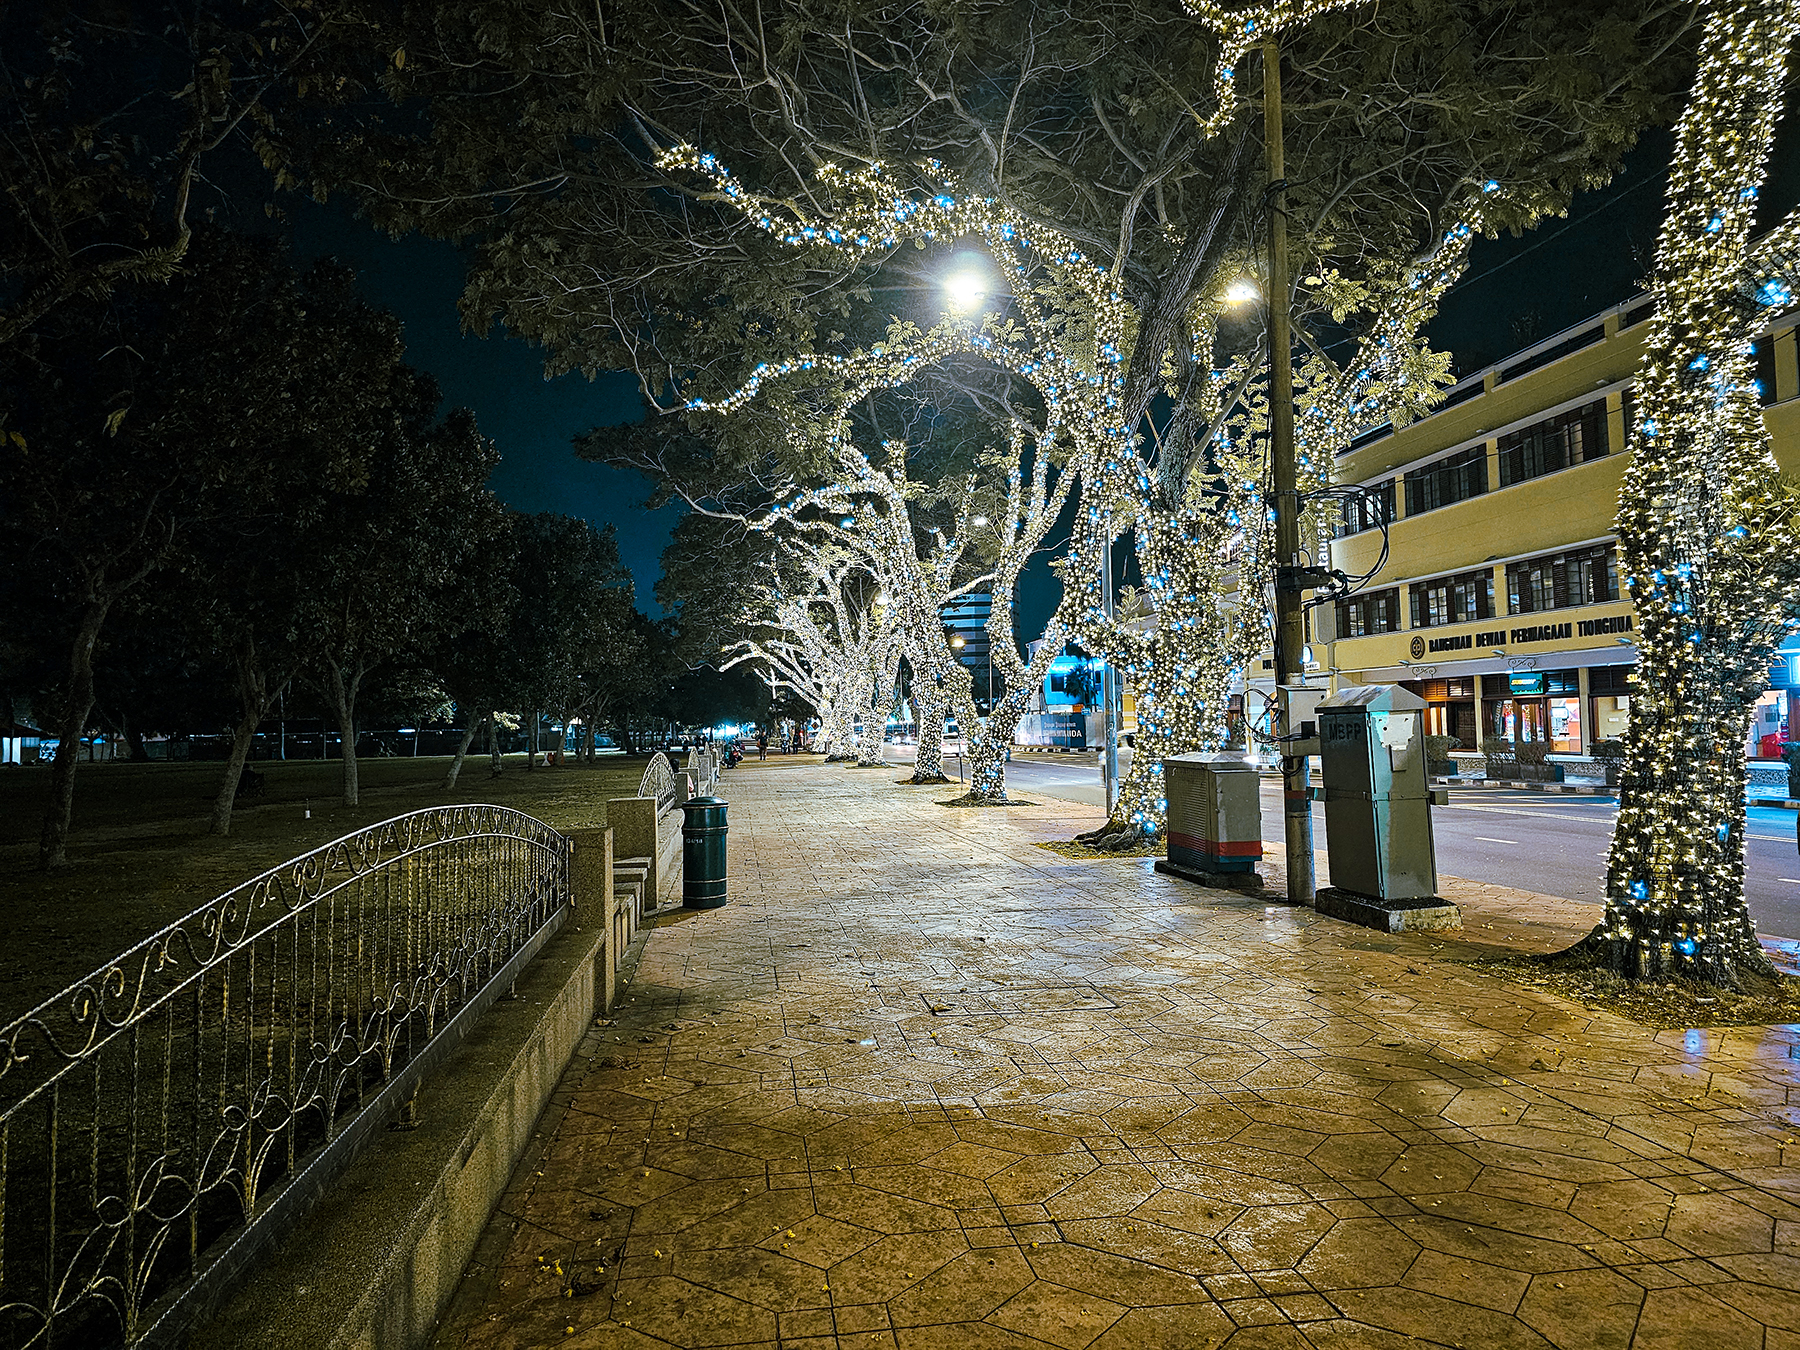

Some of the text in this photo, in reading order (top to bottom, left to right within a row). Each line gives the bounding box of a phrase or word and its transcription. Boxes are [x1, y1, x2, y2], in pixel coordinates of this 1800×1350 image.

[1429, 615, 1634, 653] BANGUNAN DEWAN PERNIAGAAN TIONGHUA
[1328, 722, 1361, 740] MBPP
